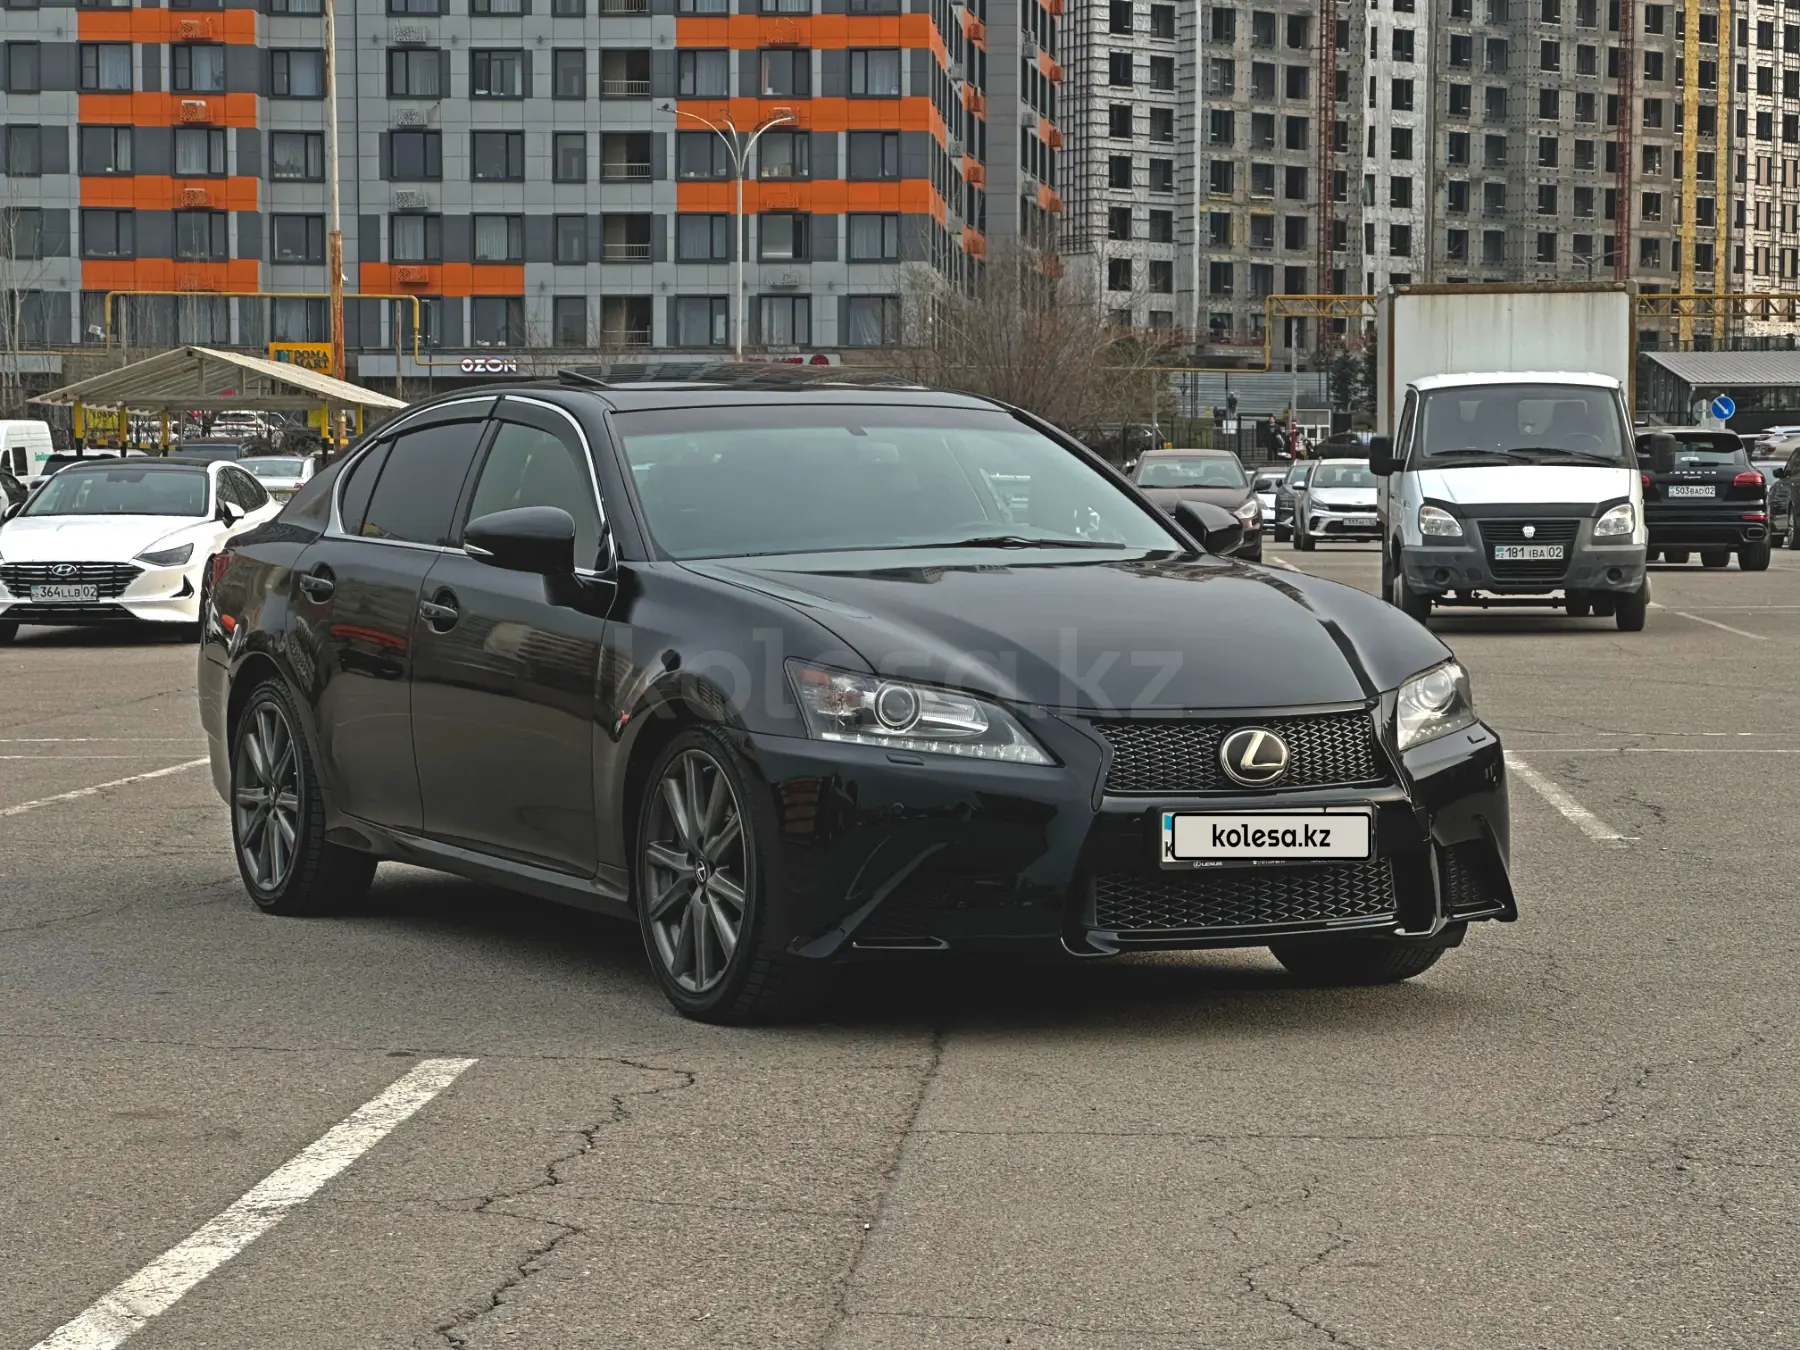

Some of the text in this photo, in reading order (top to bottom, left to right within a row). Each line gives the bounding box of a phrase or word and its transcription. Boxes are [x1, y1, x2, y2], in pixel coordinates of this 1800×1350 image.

[295, 350, 330, 360] DOMA
[294, 359, 329, 368] MART
[461, 359, 516, 372] OZON
[1506, 547, 1562, 558] 181 IBA 02
